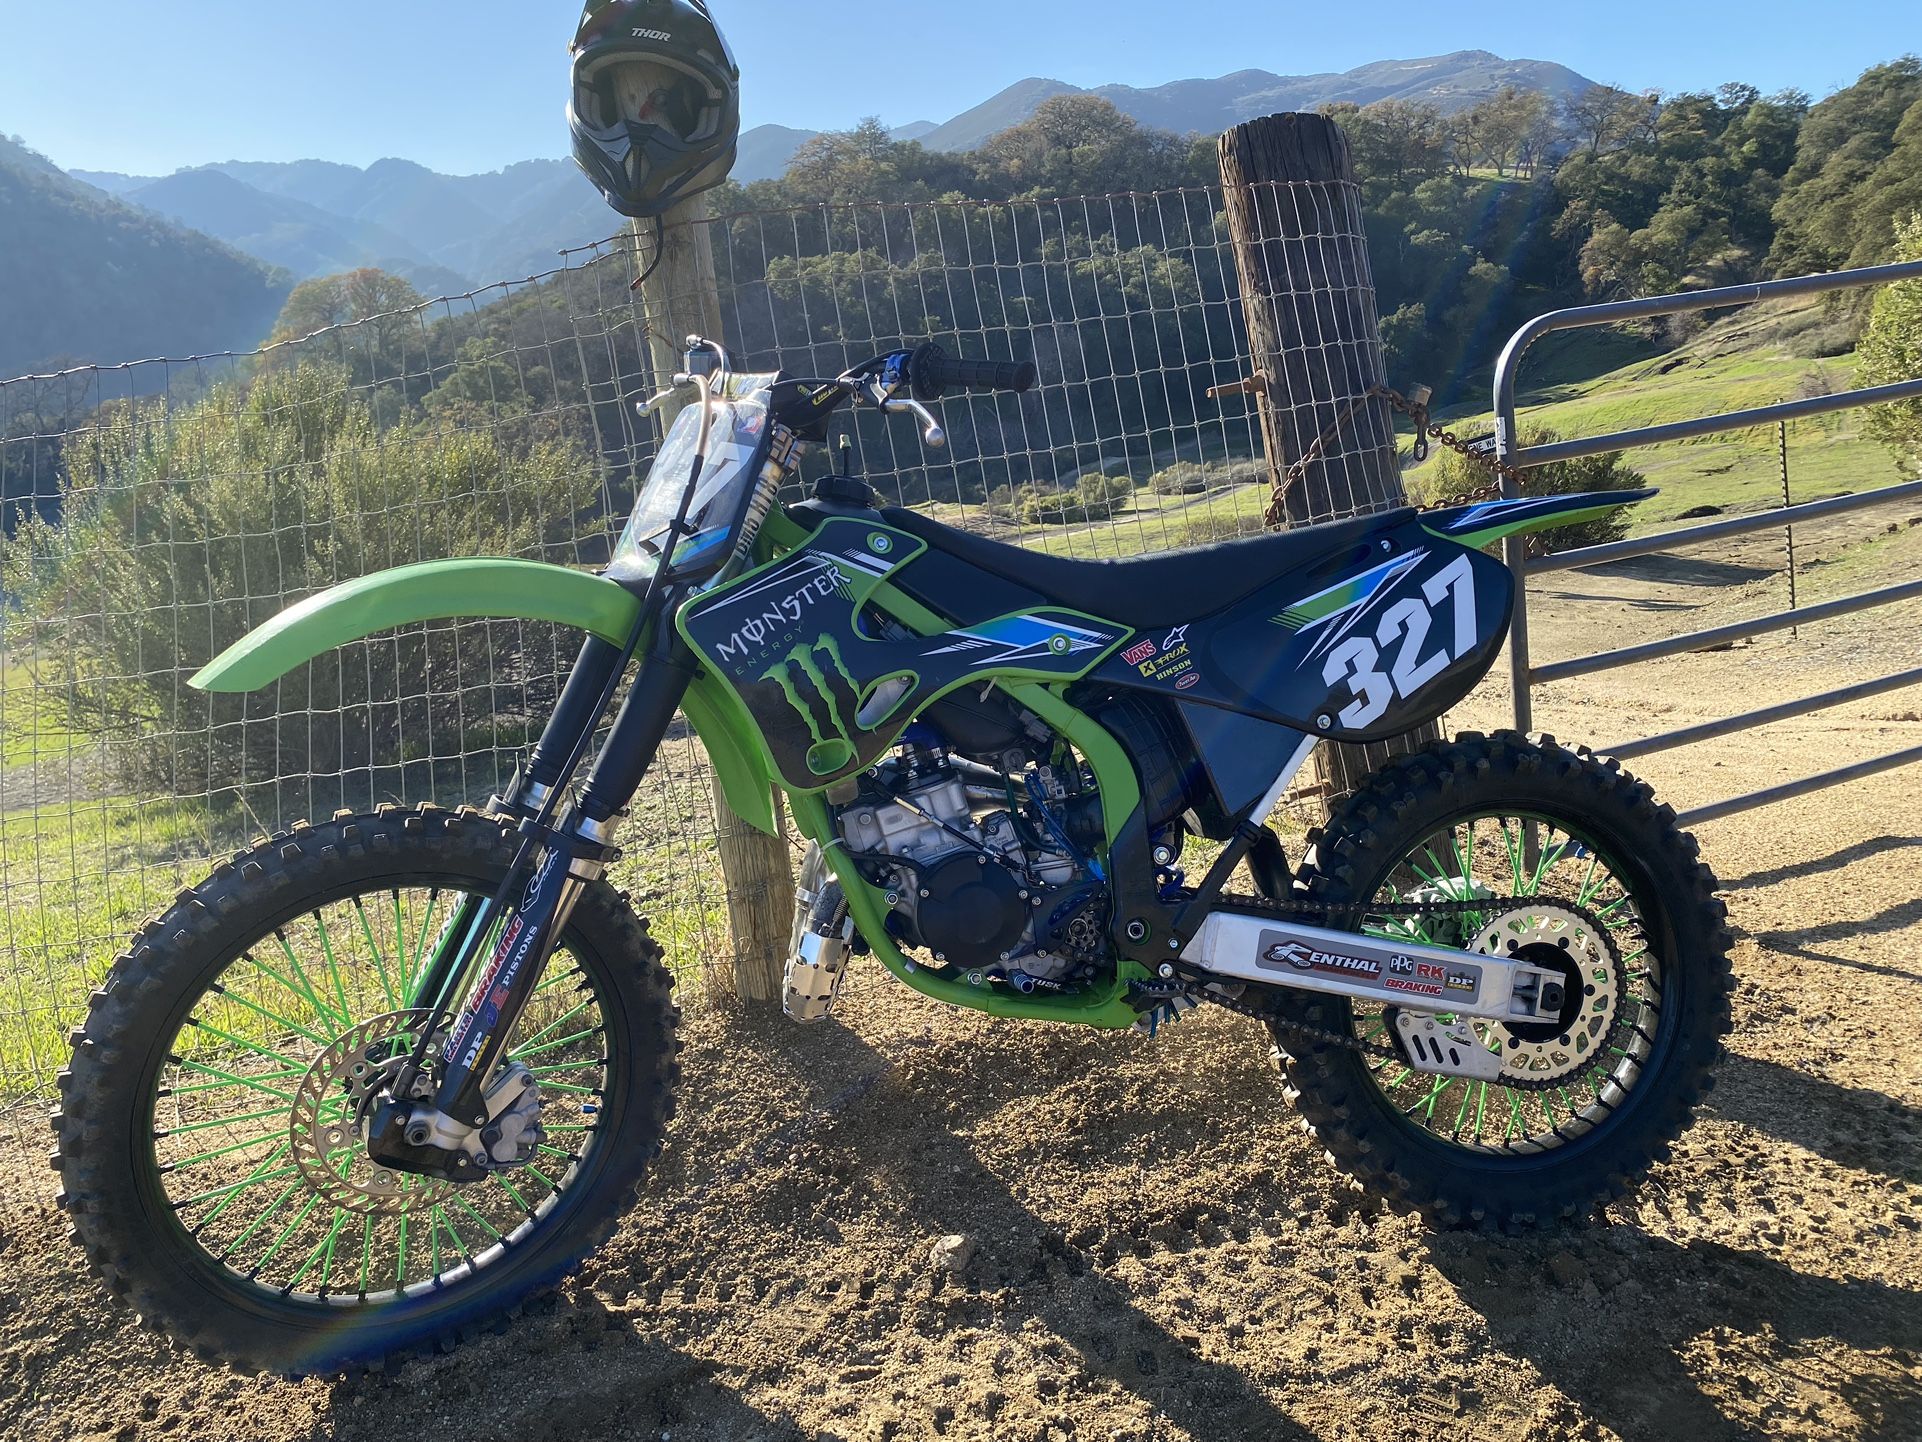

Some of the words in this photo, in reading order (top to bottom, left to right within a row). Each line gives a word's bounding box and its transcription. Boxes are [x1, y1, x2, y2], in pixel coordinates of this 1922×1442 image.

[631, 27, 671, 42] THOR
[715, 565, 852, 662] MONSTER
[736, 625, 803, 676] ENERGY
[1121, 639, 1156, 665] VANS
[1321, 552, 1477, 730] 327
[1156, 659, 1192, 681] HINSON
[471, 914, 524, 1014] BRAKING
[502, 925, 538, 987] PISTONS
[1031, 978, 1061, 989] TUSK
[1416, 963, 1445, 980] RK
[1448, 975, 1474, 986] DP
[1384, 978, 1444, 996] BRAKING
[461, 1031, 484, 1069] DP
